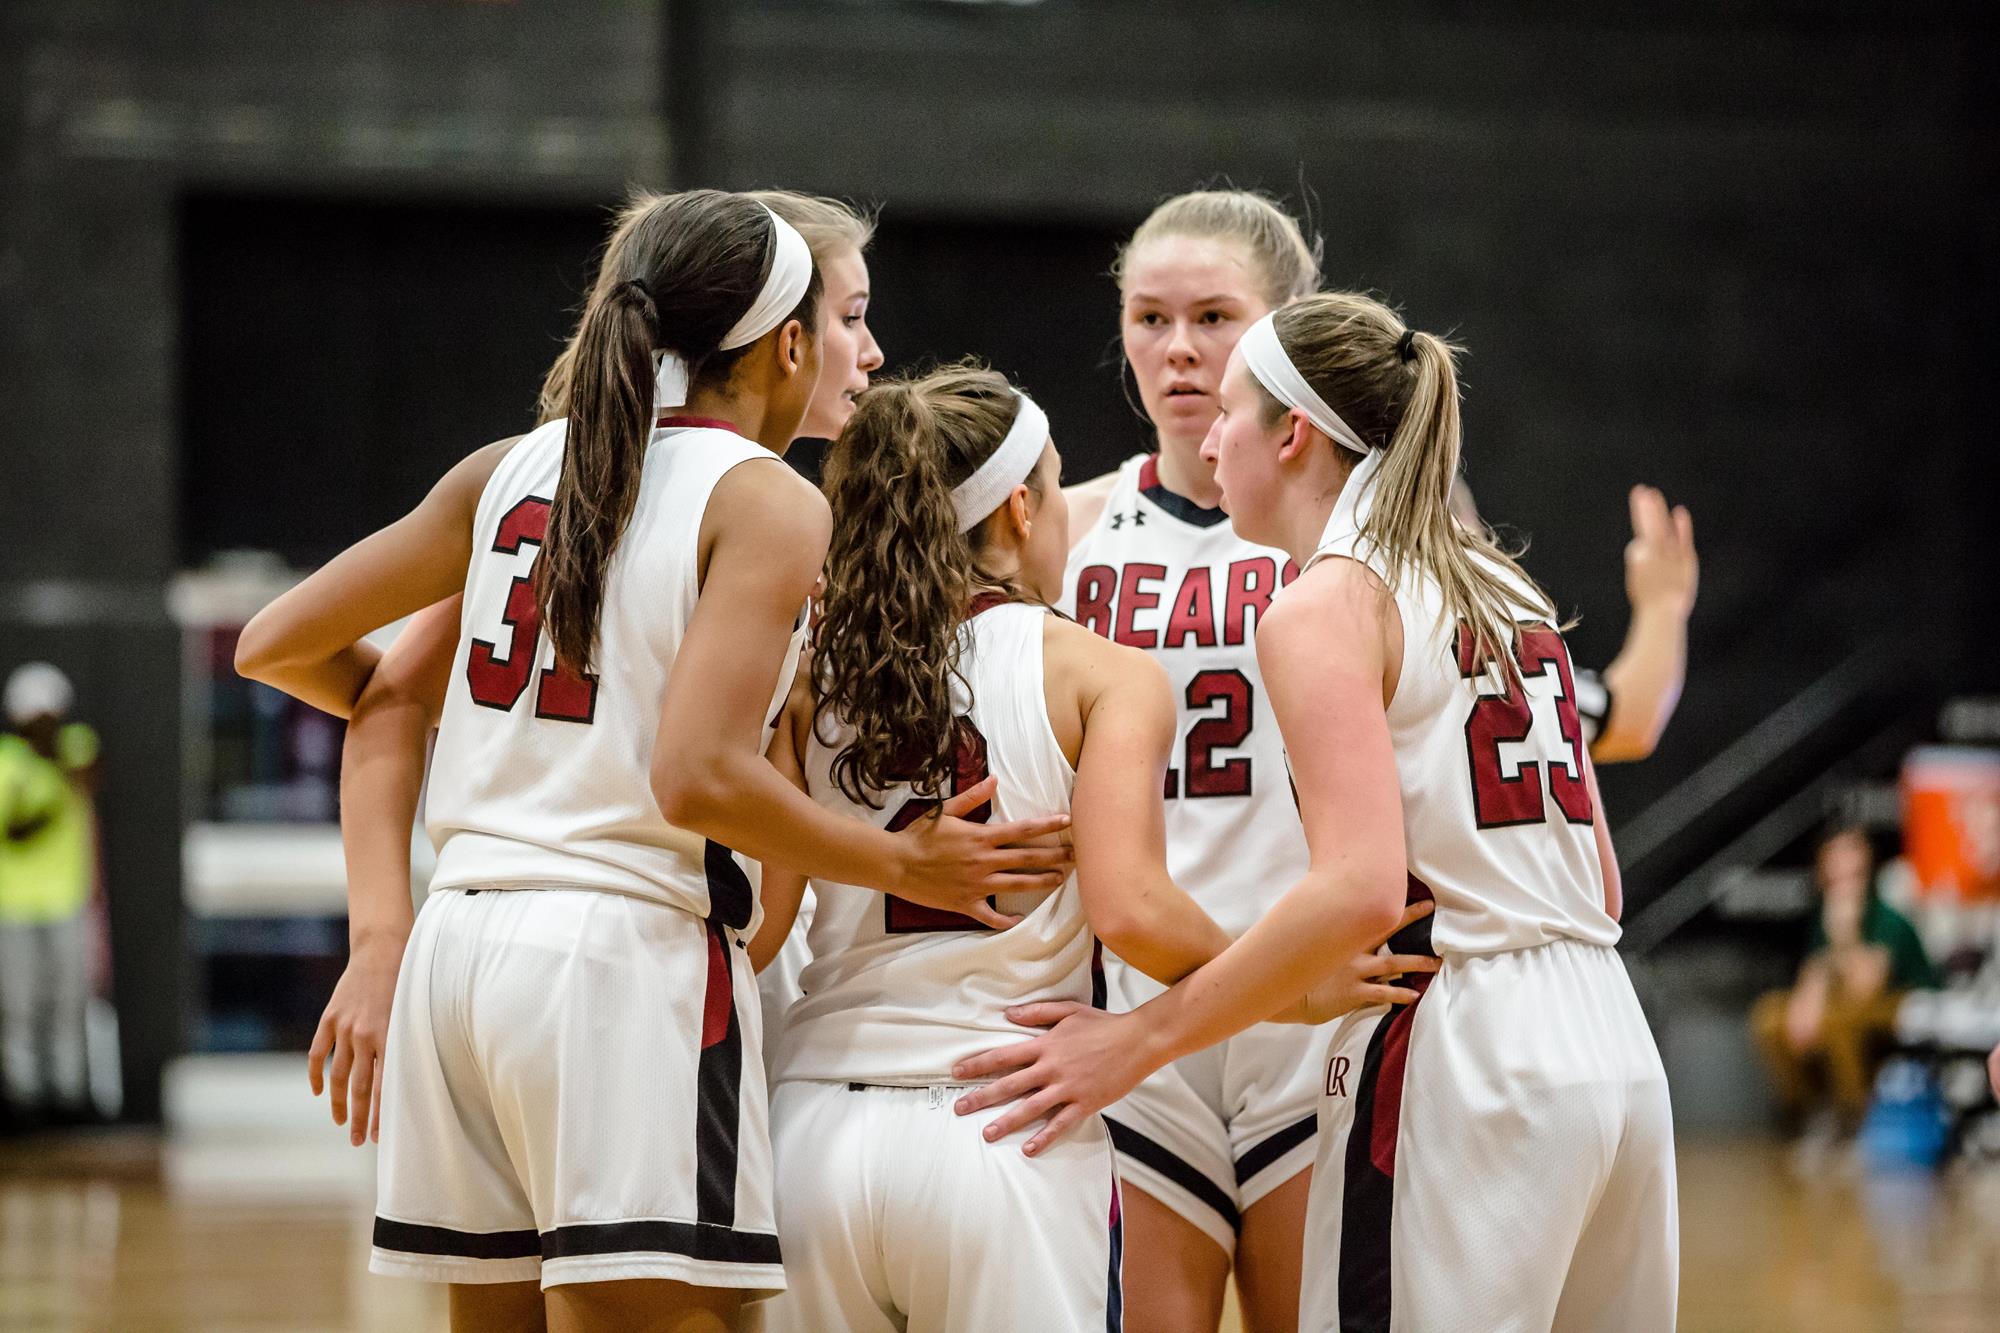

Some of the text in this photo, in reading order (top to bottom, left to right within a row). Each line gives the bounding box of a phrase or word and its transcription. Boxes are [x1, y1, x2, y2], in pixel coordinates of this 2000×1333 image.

[1075, 556, 1300, 648] BEAR
[1163, 668, 1254, 800] 2
[1451, 617, 1594, 830] 23
[1325, 1056, 1350, 1097] LR
